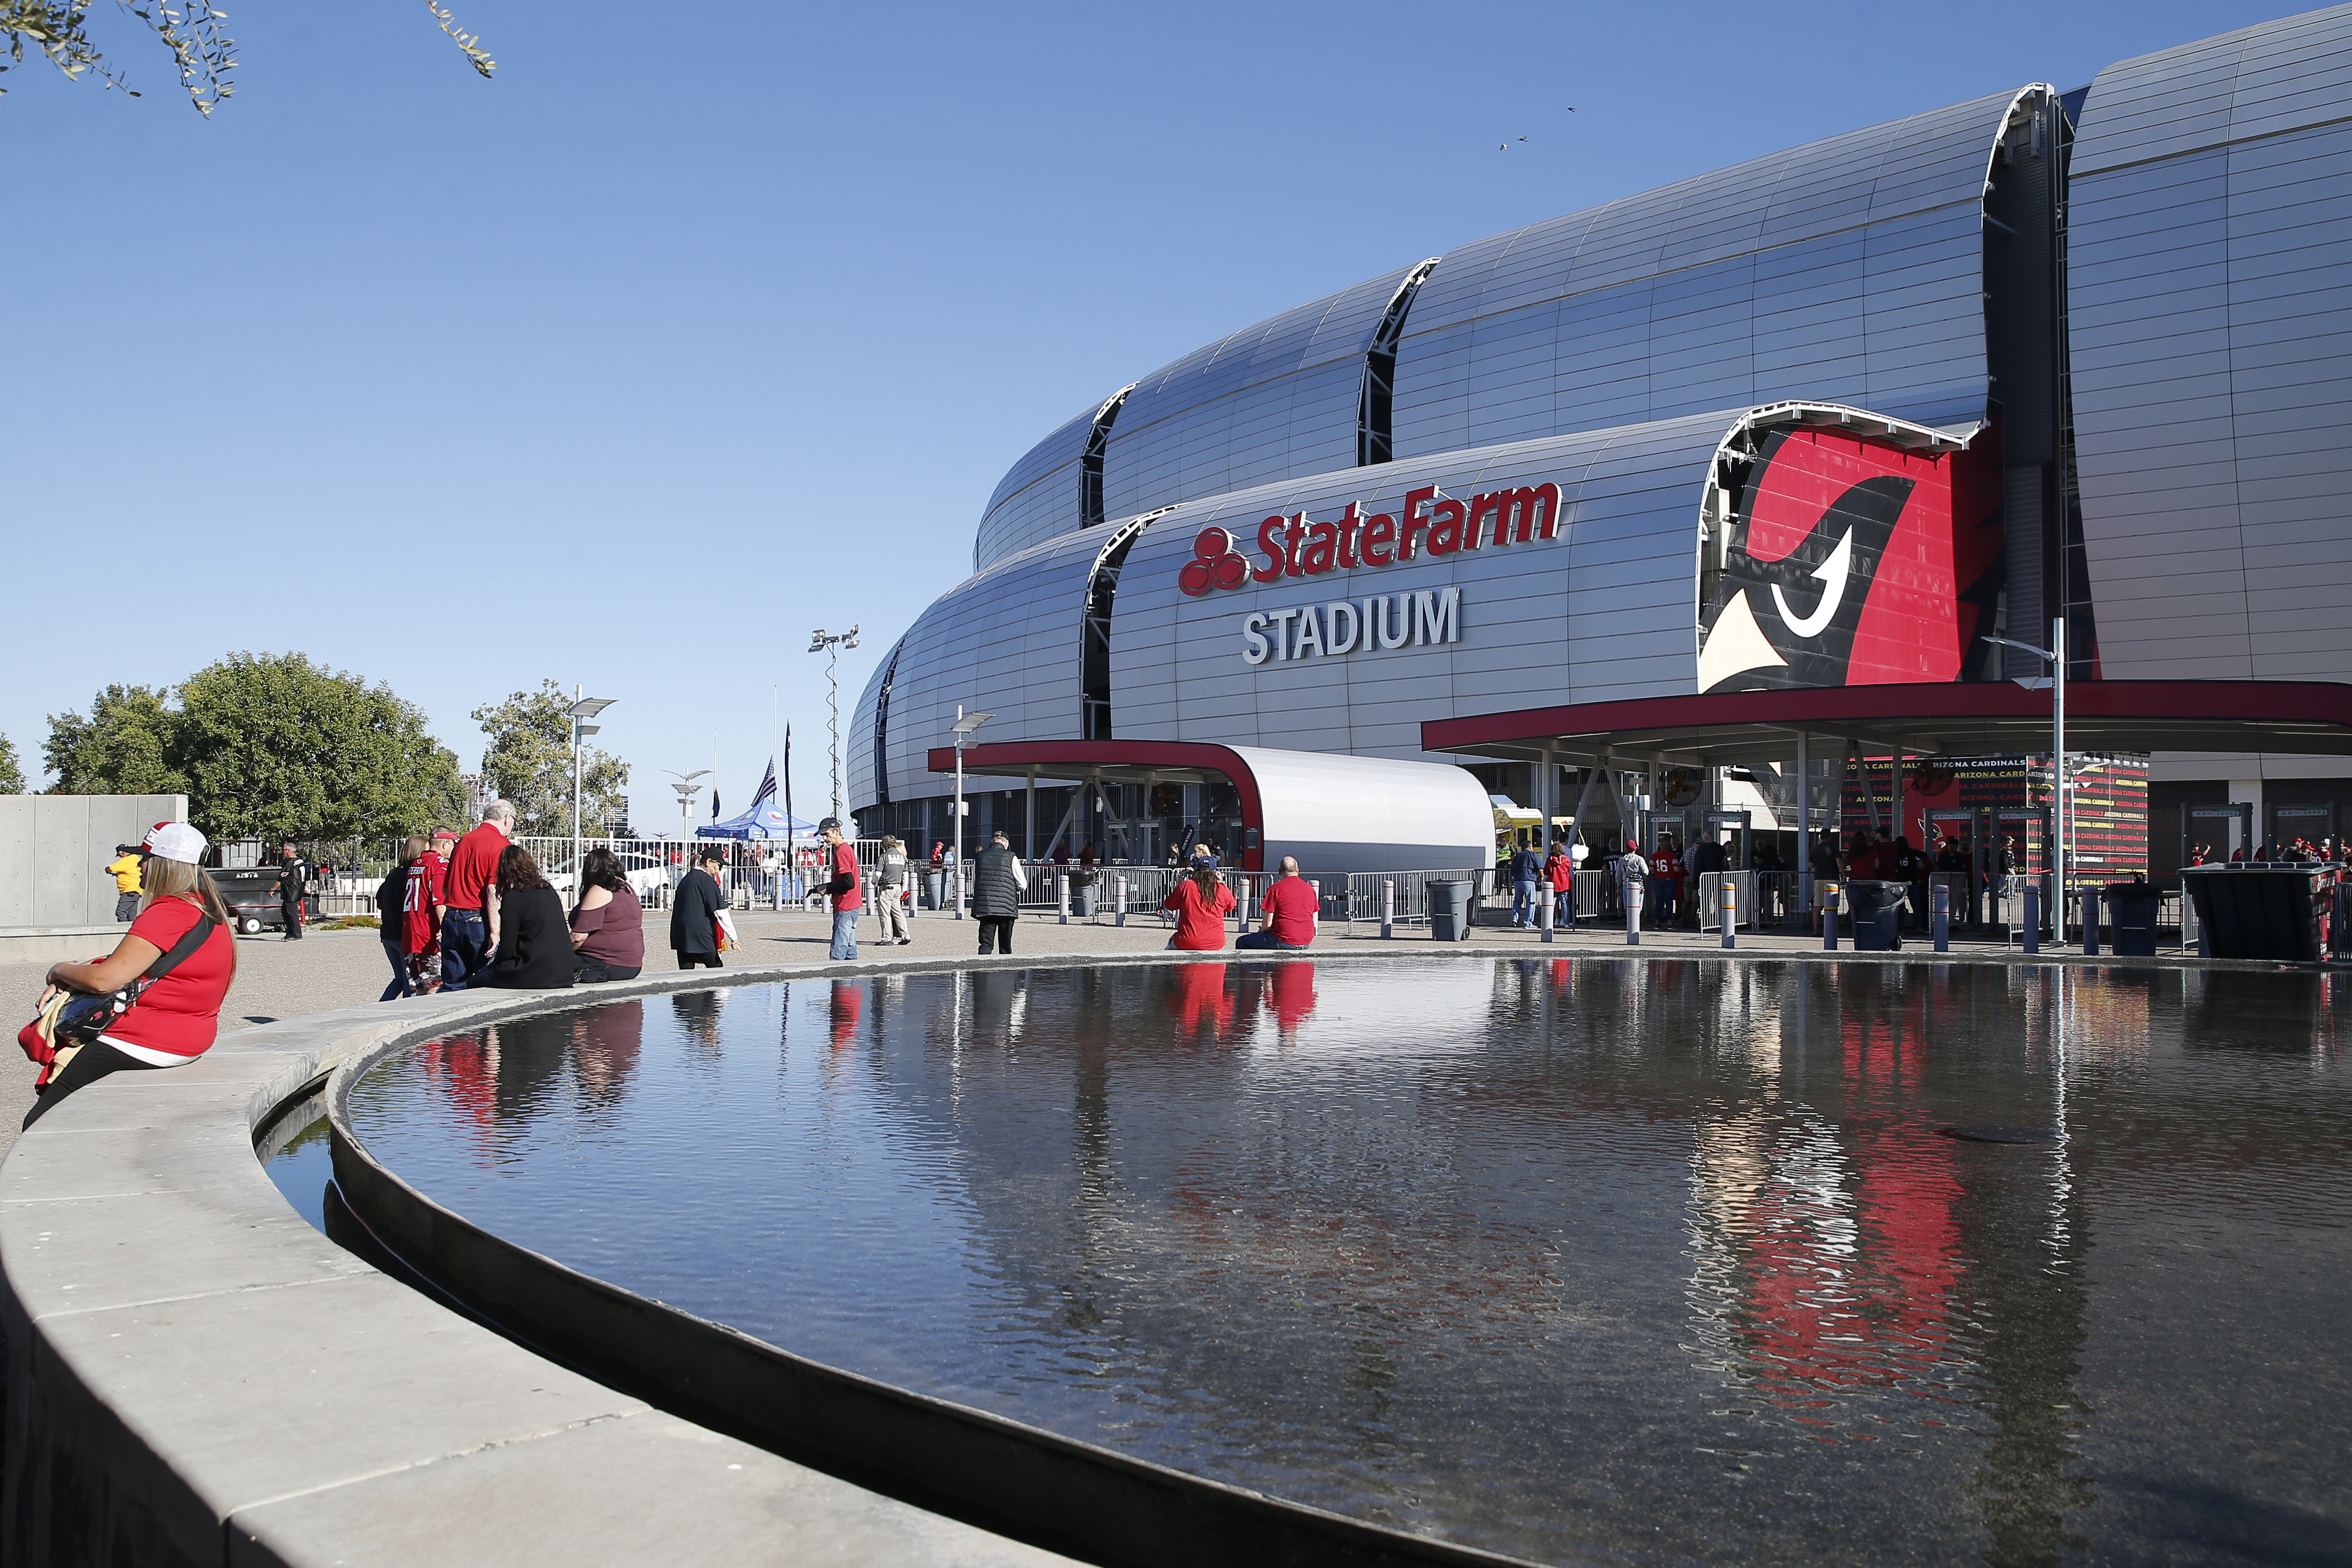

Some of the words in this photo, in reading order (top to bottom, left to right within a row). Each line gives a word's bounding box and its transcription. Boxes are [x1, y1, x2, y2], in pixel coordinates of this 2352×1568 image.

[1241, 587, 1460, 665] STADIUM
[1182, 829, 1193, 850] COCKTAILS
[1656, 859, 1668, 872] 16
[403, 877, 420, 912] 21
